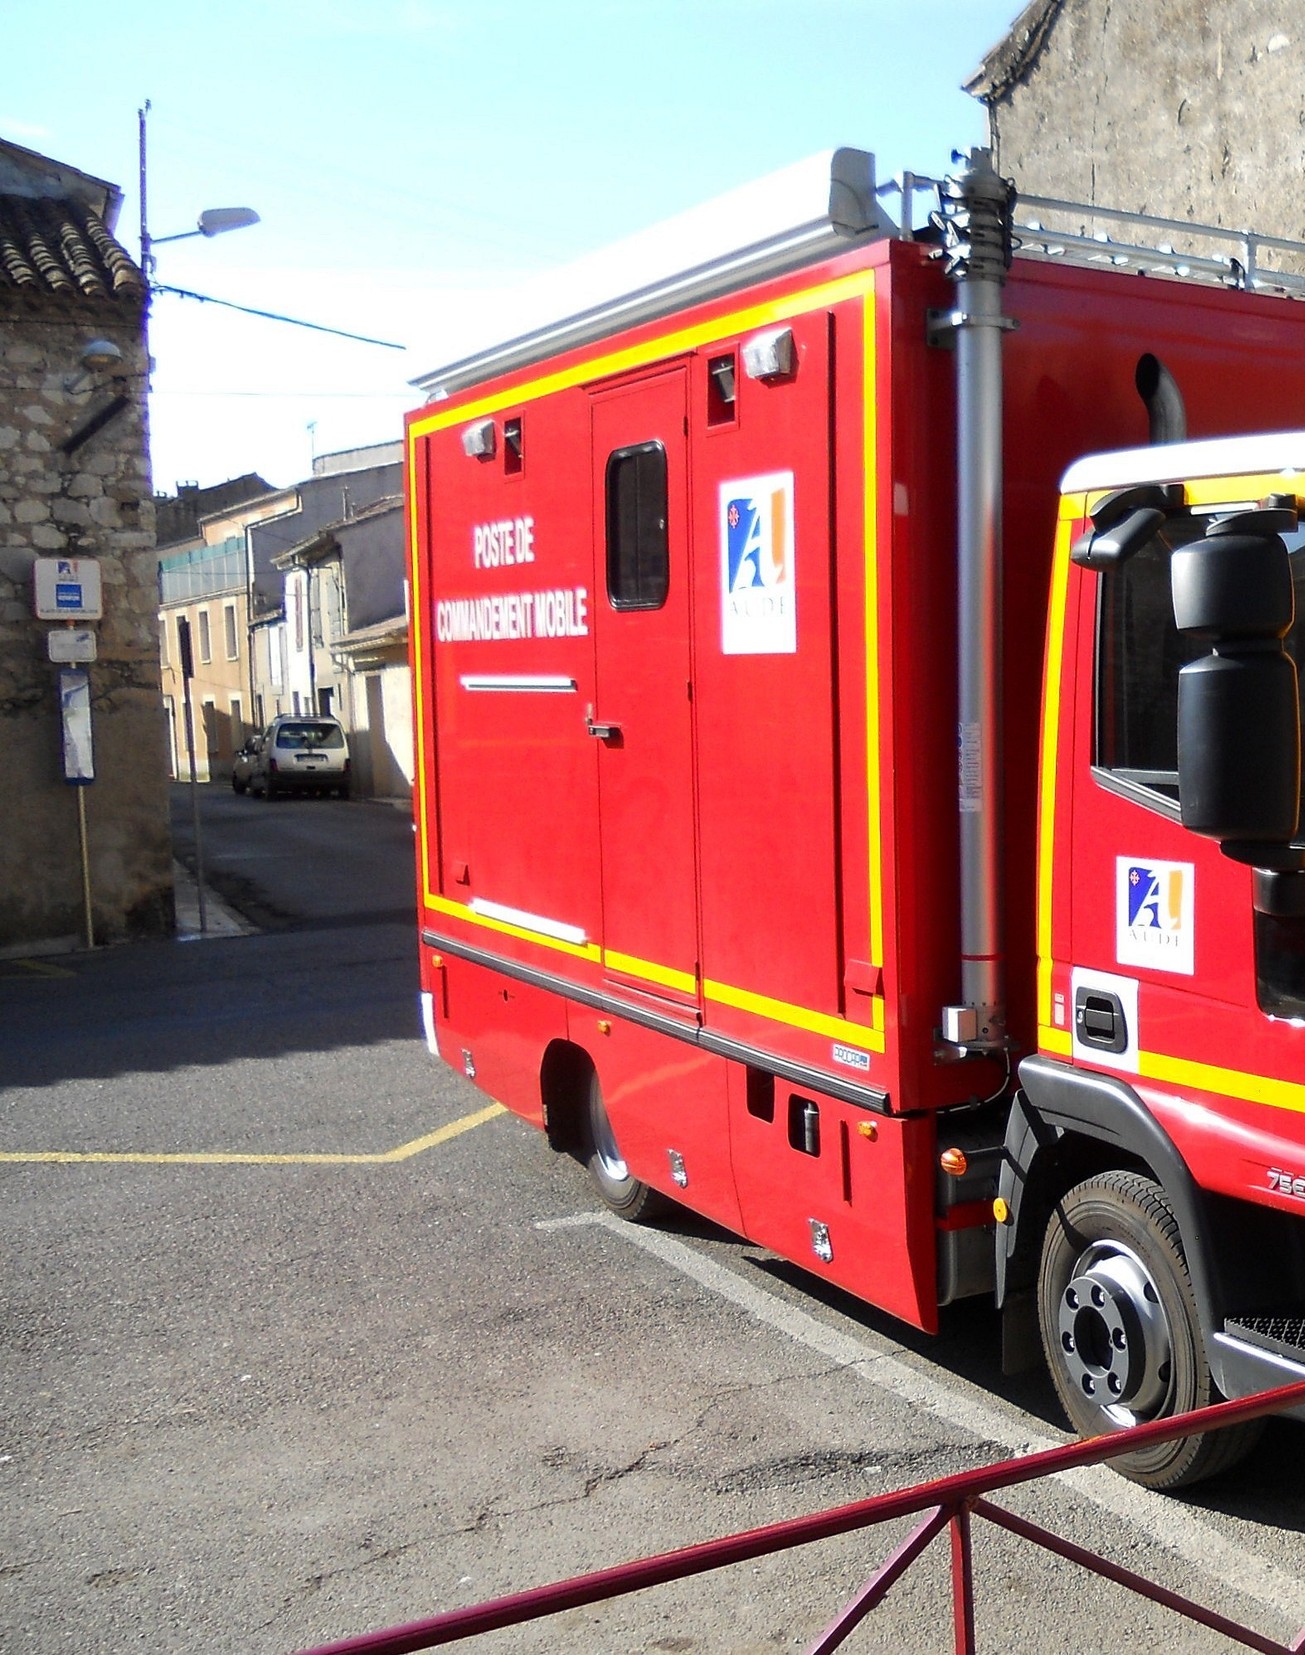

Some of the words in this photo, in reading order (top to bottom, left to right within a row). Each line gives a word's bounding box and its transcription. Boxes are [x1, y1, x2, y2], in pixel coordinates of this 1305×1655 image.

[474, 520, 514, 569] POSTE
[514, 516, 535, 563] DE
[437, 593, 533, 642] COMMANDEMENT
[533, 587, 588, 638] MOBILE
